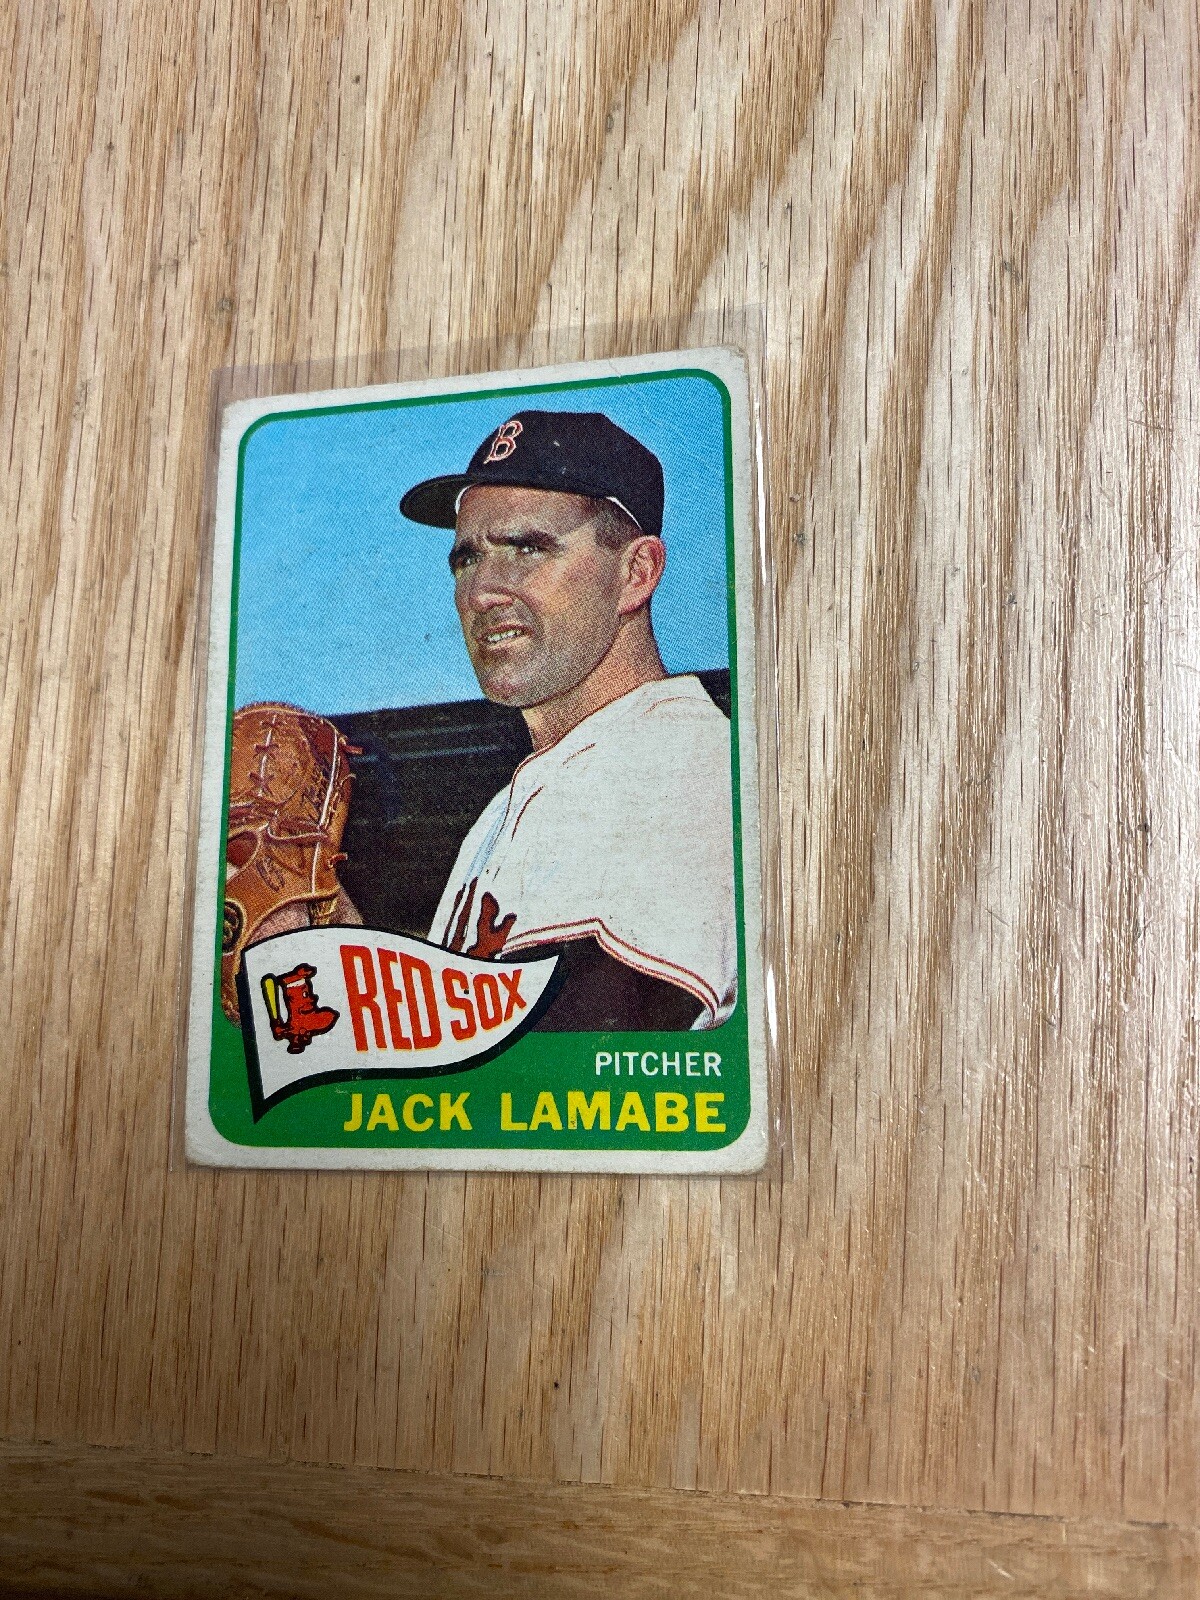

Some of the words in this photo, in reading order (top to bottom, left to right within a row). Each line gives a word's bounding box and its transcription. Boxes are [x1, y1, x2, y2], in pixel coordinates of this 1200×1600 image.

[483, 420, 523, 464] B
[339, 943, 442, 1052] RED
[443, 968, 528, 1041] SOX
[595, 1051, 722, 1077] PITCHER
[343, 1092, 473, 1132] JACK
[500, 1091, 727, 1133] LAMABE
